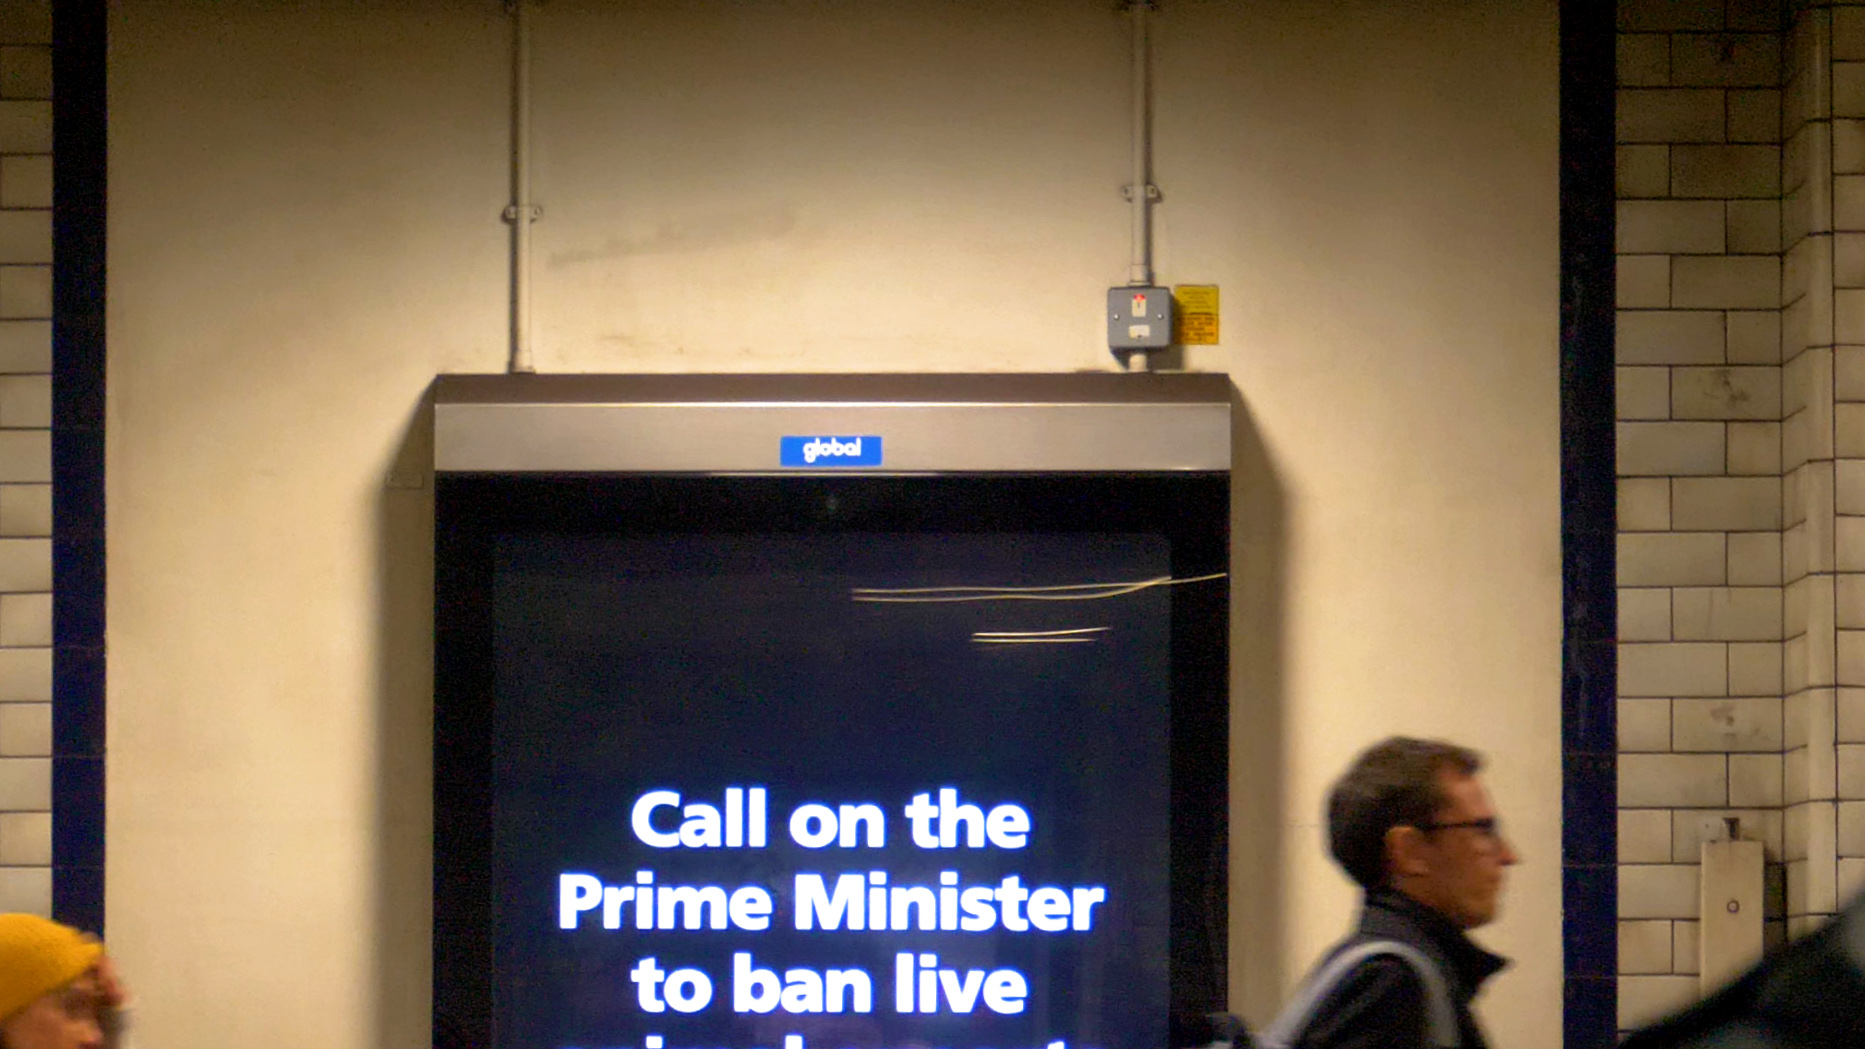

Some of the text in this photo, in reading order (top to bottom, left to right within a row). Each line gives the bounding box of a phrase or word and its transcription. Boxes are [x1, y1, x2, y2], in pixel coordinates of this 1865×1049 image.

[802, 437, 862, 462] global
[632, 788, 1031, 849] Call on the
[559, 870, 1106, 932] Prime Minister
[631, 952, 1028, 1014] to ban live
